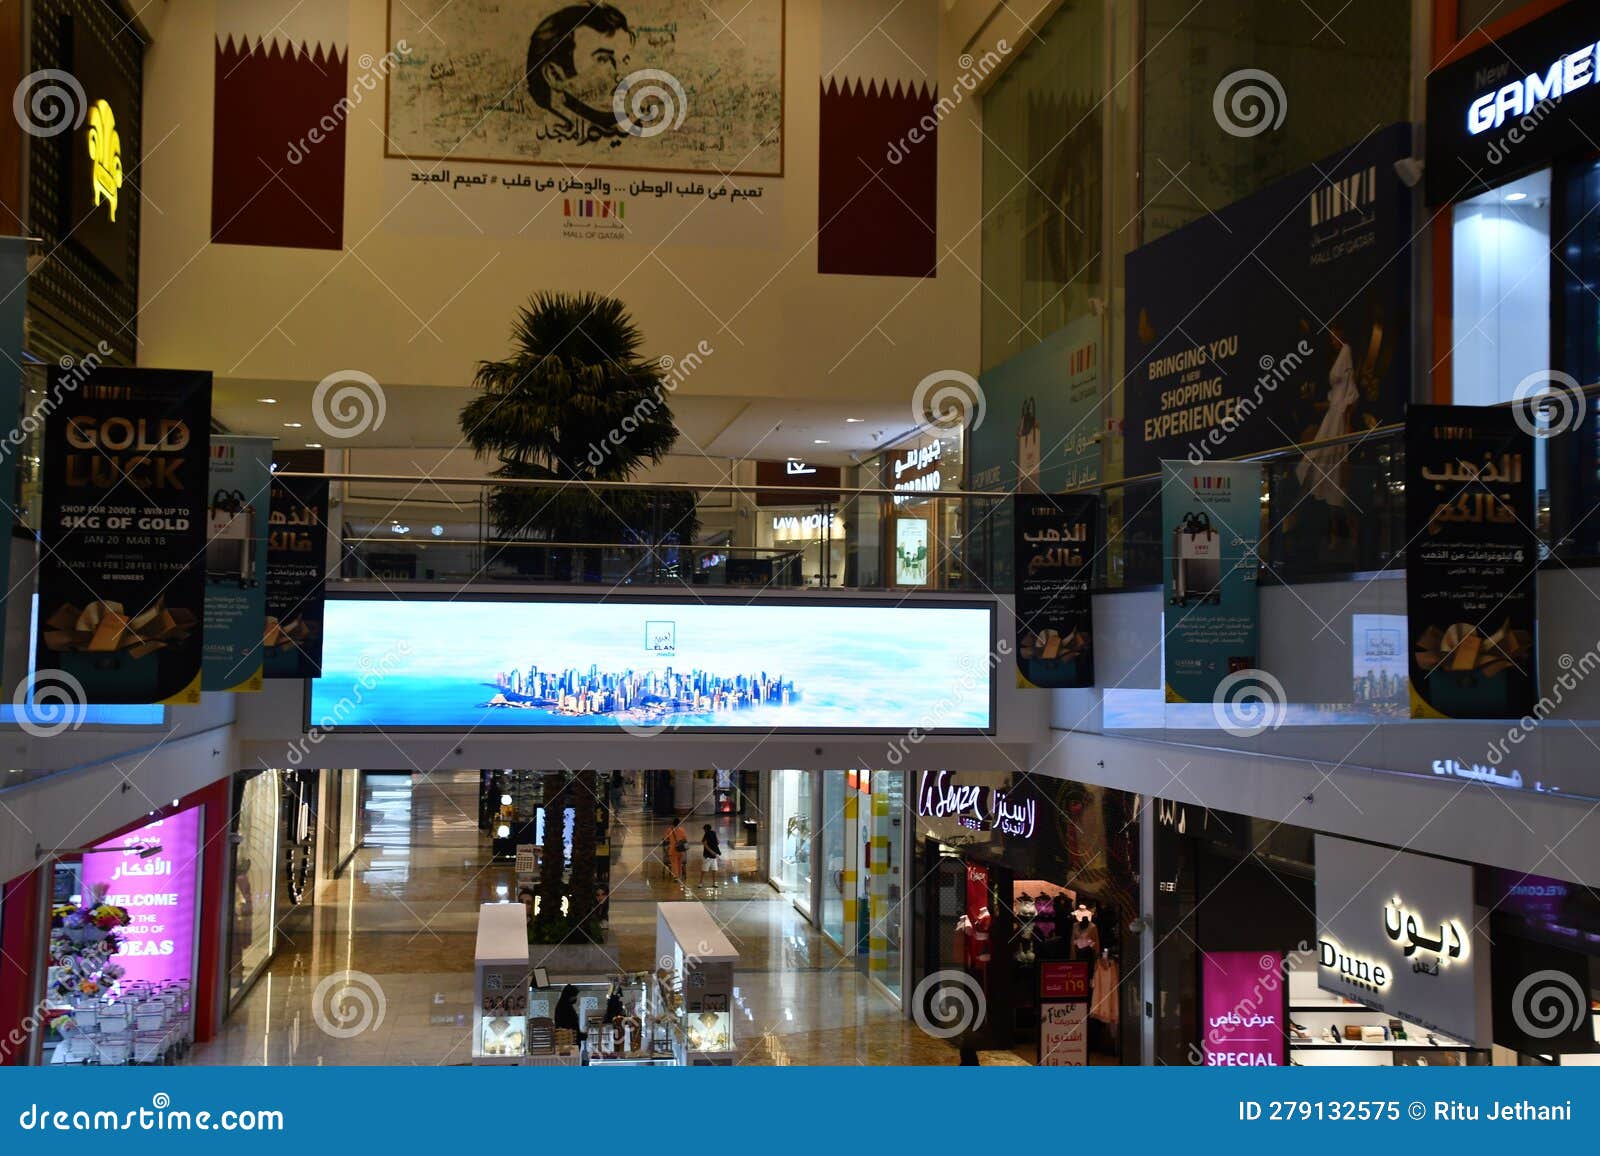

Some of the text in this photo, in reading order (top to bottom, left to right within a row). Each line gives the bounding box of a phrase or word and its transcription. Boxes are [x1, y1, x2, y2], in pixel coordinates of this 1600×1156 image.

[1468, 40, 1600, 136] GAME
[411, 171, 451, 188] المجد
[453, 173, 487, 190] تميم
[502, 174, 533, 193] قلب
[558, 177, 612, 197] والوطن
[629, 181, 673, 198] الوطن
[676, 181, 706, 200] قلب
[730, 185, 764, 203] تميم
[563, 230, 625, 241] MALL OF QATAR
[1332, 243, 1345, 259] OF
[1148, 335, 1240, 382] BRINGING YOU
[1160, 376, 1223, 412] SHOPPING
[65, 416, 191, 453] GOLD
[64, 454, 186, 491] LUCK
[60, 504, 86, 514] SHOP
[163, 507, 176, 516] UP
[177, 507, 190, 517] TO
[60, 515, 191, 531] 4KG OF GOLD
[773, 516, 800, 530] LAVA
[84, 535, 105, 545] JAN
[106, 536, 119, 545] 20
[126, 536, 150, 545] MAR
[154, 536, 168, 546] 18
[139, 914, 157, 923] THE
[151, 925, 165, 934] OF
[1318, 939, 1387, 988] Dune
[1210, 1011, 1276, 1028] عرض خاص
[1207, 1053, 1278, 1066] SPECIAL
